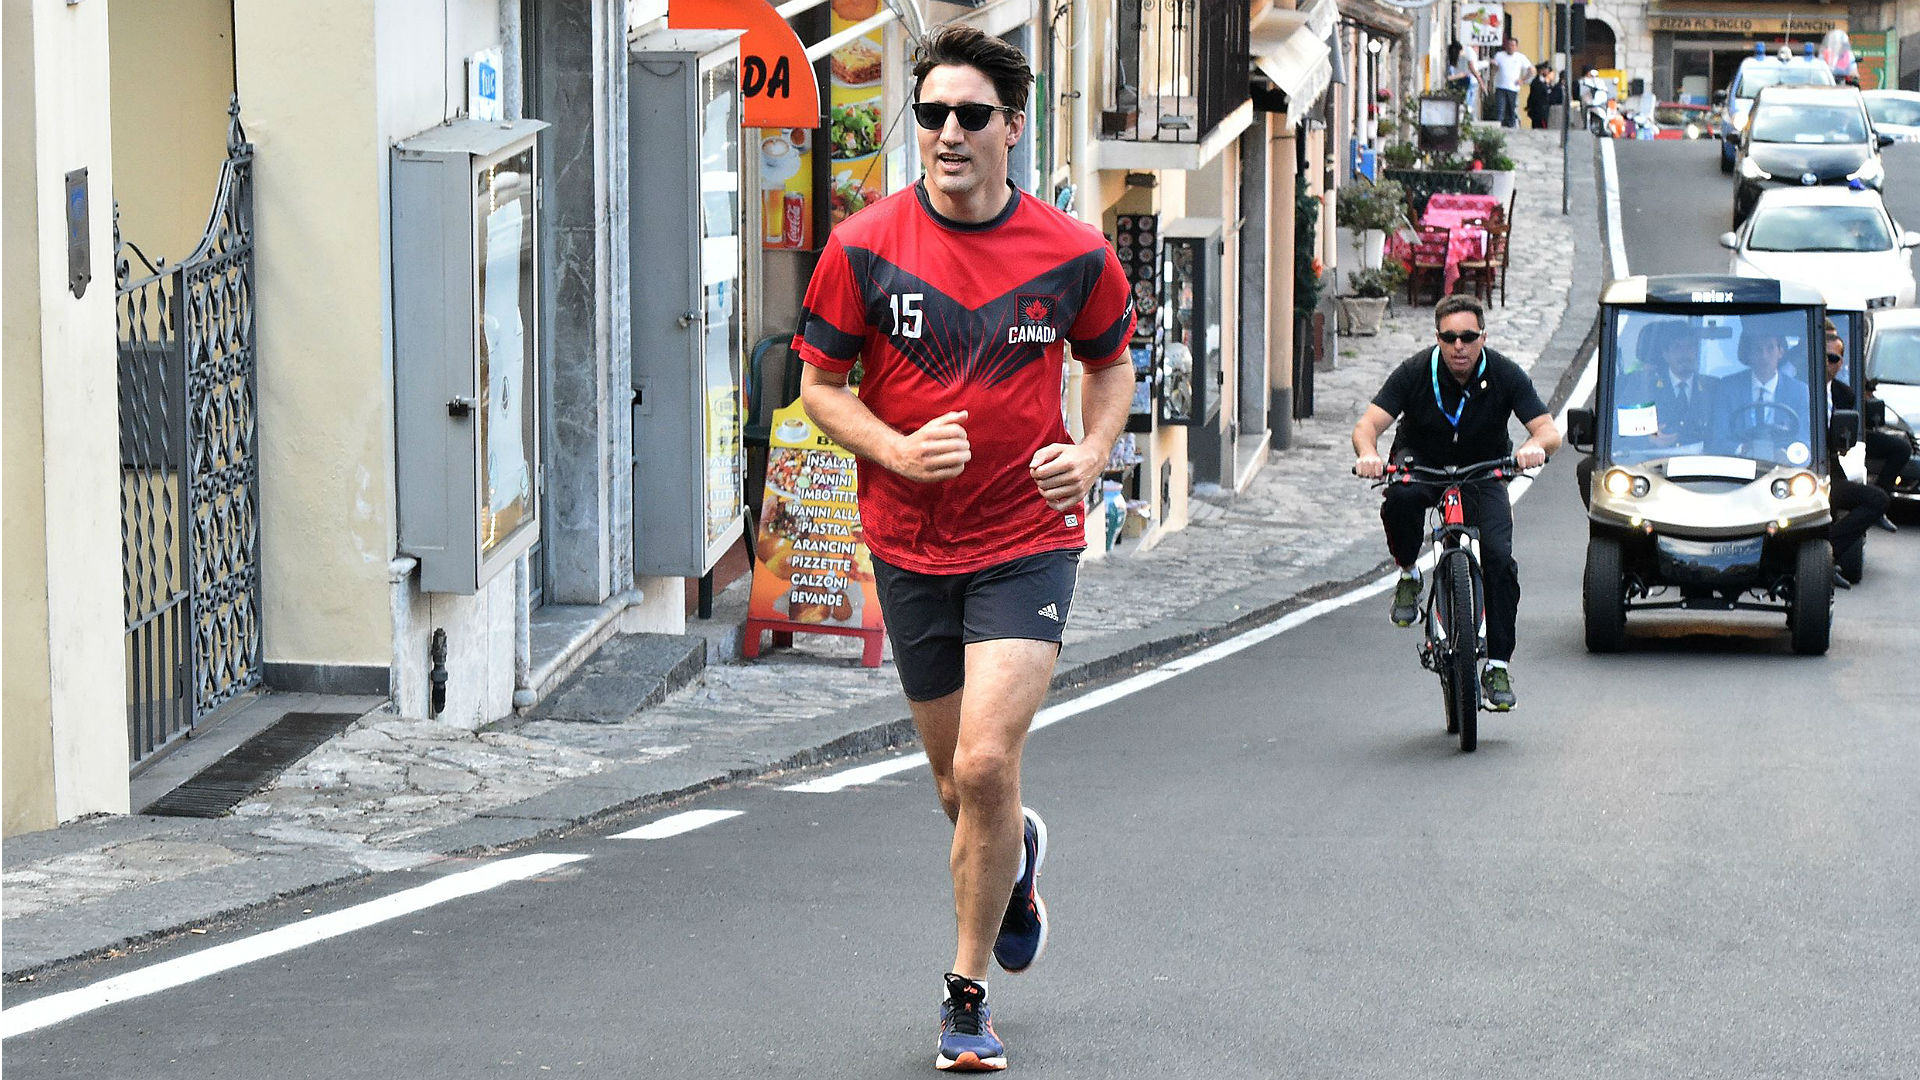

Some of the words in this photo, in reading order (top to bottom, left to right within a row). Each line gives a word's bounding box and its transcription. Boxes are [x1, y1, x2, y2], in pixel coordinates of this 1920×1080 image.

[1659, 16, 1691, 28] PIZZA
[1695, 17, 1707, 28] AL
[1712, 18, 1752, 29] TAGLIO
[1780, 19, 1836, 30] ARANCINI
[742, 55, 789, 98] DA
[890, 293, 924, 339] 15
[1008, 325, 1056, 344] CANADA
[813, 473, 852, 487] PANINI
[792, 505, 830, 518] PANINI
[833, 508, 861, 520] ALLA
[801, 522, 849, 535] PIASTRA
[793, 539, 856, 554] ARANCINI
[791, 556, 851, 571] PIZZETTE
[791, 573, 848, 589] CALZONI
[791, 591, 843, 606] BEVANDE
